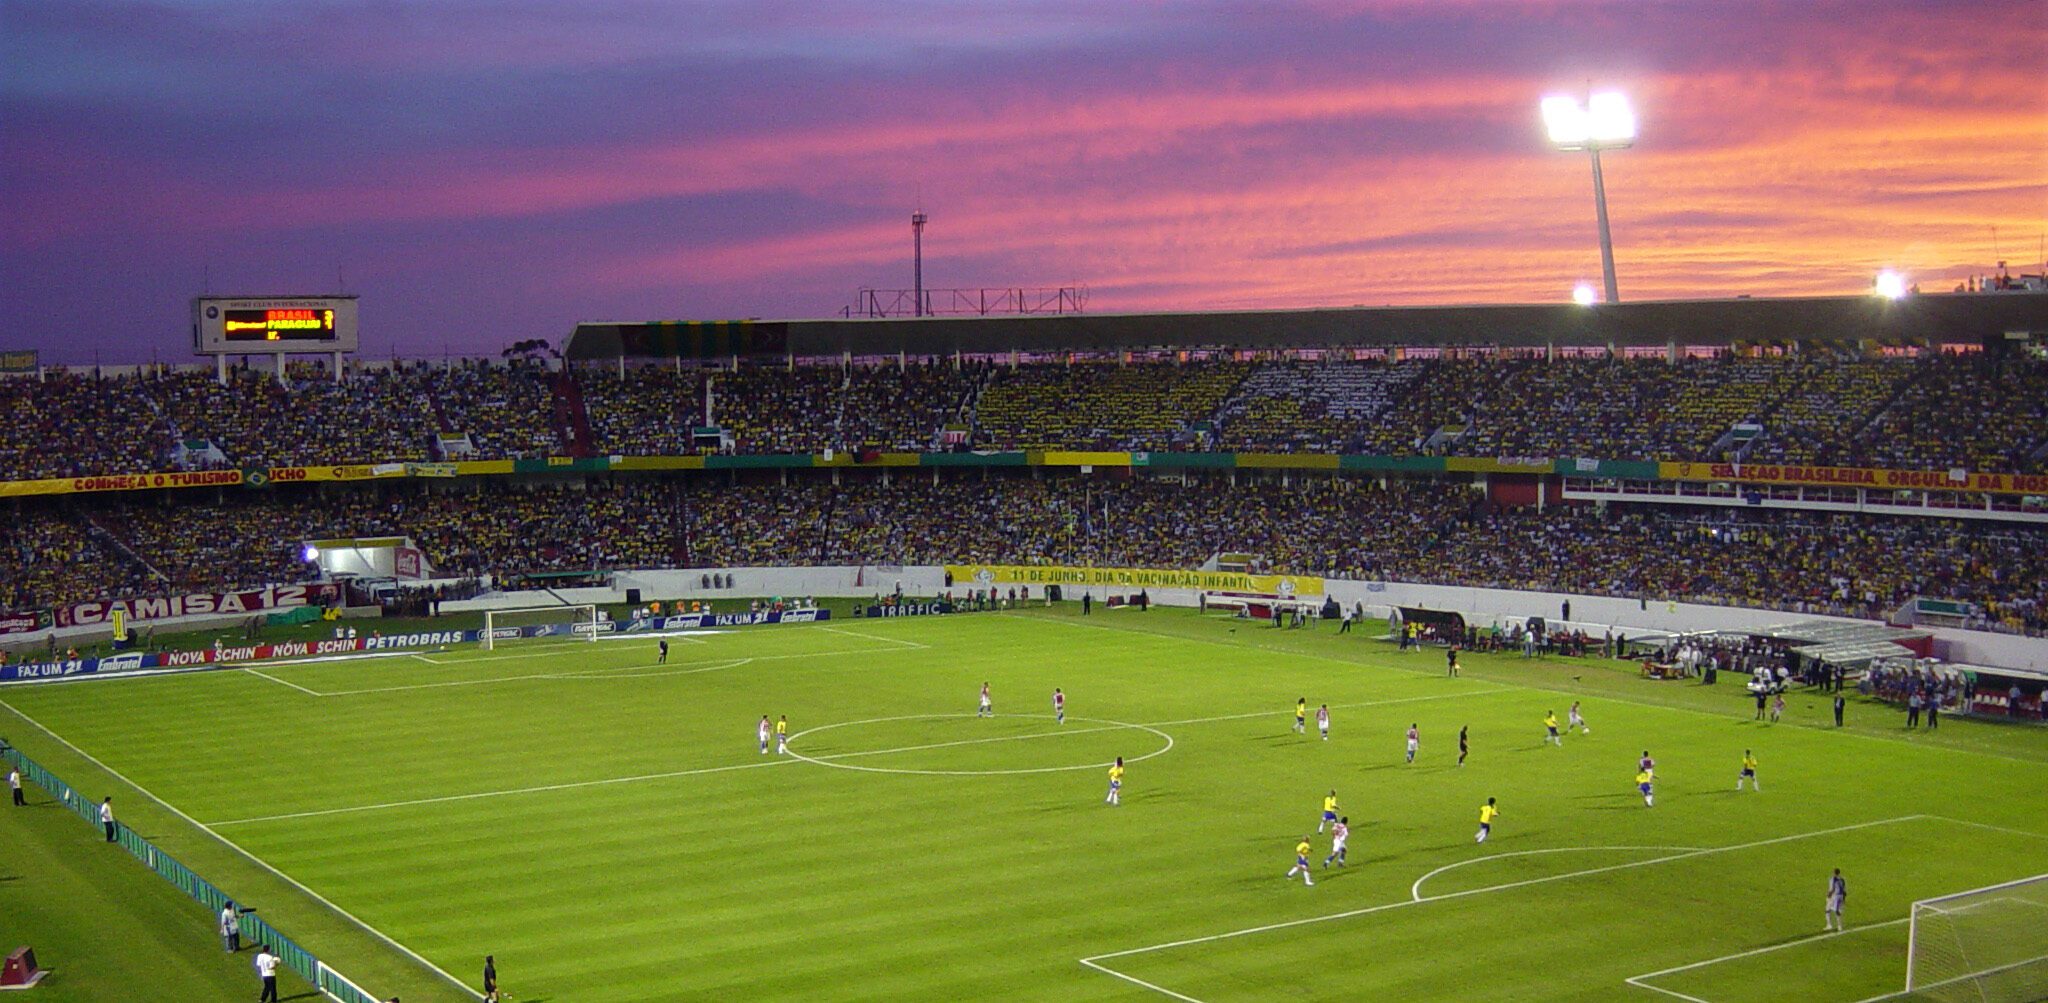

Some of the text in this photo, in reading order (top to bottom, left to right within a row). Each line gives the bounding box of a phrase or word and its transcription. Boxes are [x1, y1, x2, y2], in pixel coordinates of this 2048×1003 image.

[268, 311, 315, 320] BRASIL
[74, 476, 148, 491] CONHEÇA
[154, 474, 165, 486] O
[170, 471, 240, 486] TURISMO
[1978, 474, 2002, 489] DA
[1012, 570, 1025, 580] 11
[1030, 571, 1044, 581] DE
[1095, 571, 1113, 582] DIA
[1119, 572, 1133, 582] DA
[73, 587, 307, 624] CAMISA 12
[880, 603, 940, 617] TRAFFIC
[715, 614, 733, 626] FAZ
[735, 613, 751, 624] UM
[366, 631, 462, 649] PETROBRAS
[273, 639, 357, 657] NOVA SCHIN
[98, 657, 141, 671] Embratel
[168, 648, 256, 666] NOVA SCHIN
[18, 665, 39, 677] FAZ
[42, 663, 62, 675] UM
